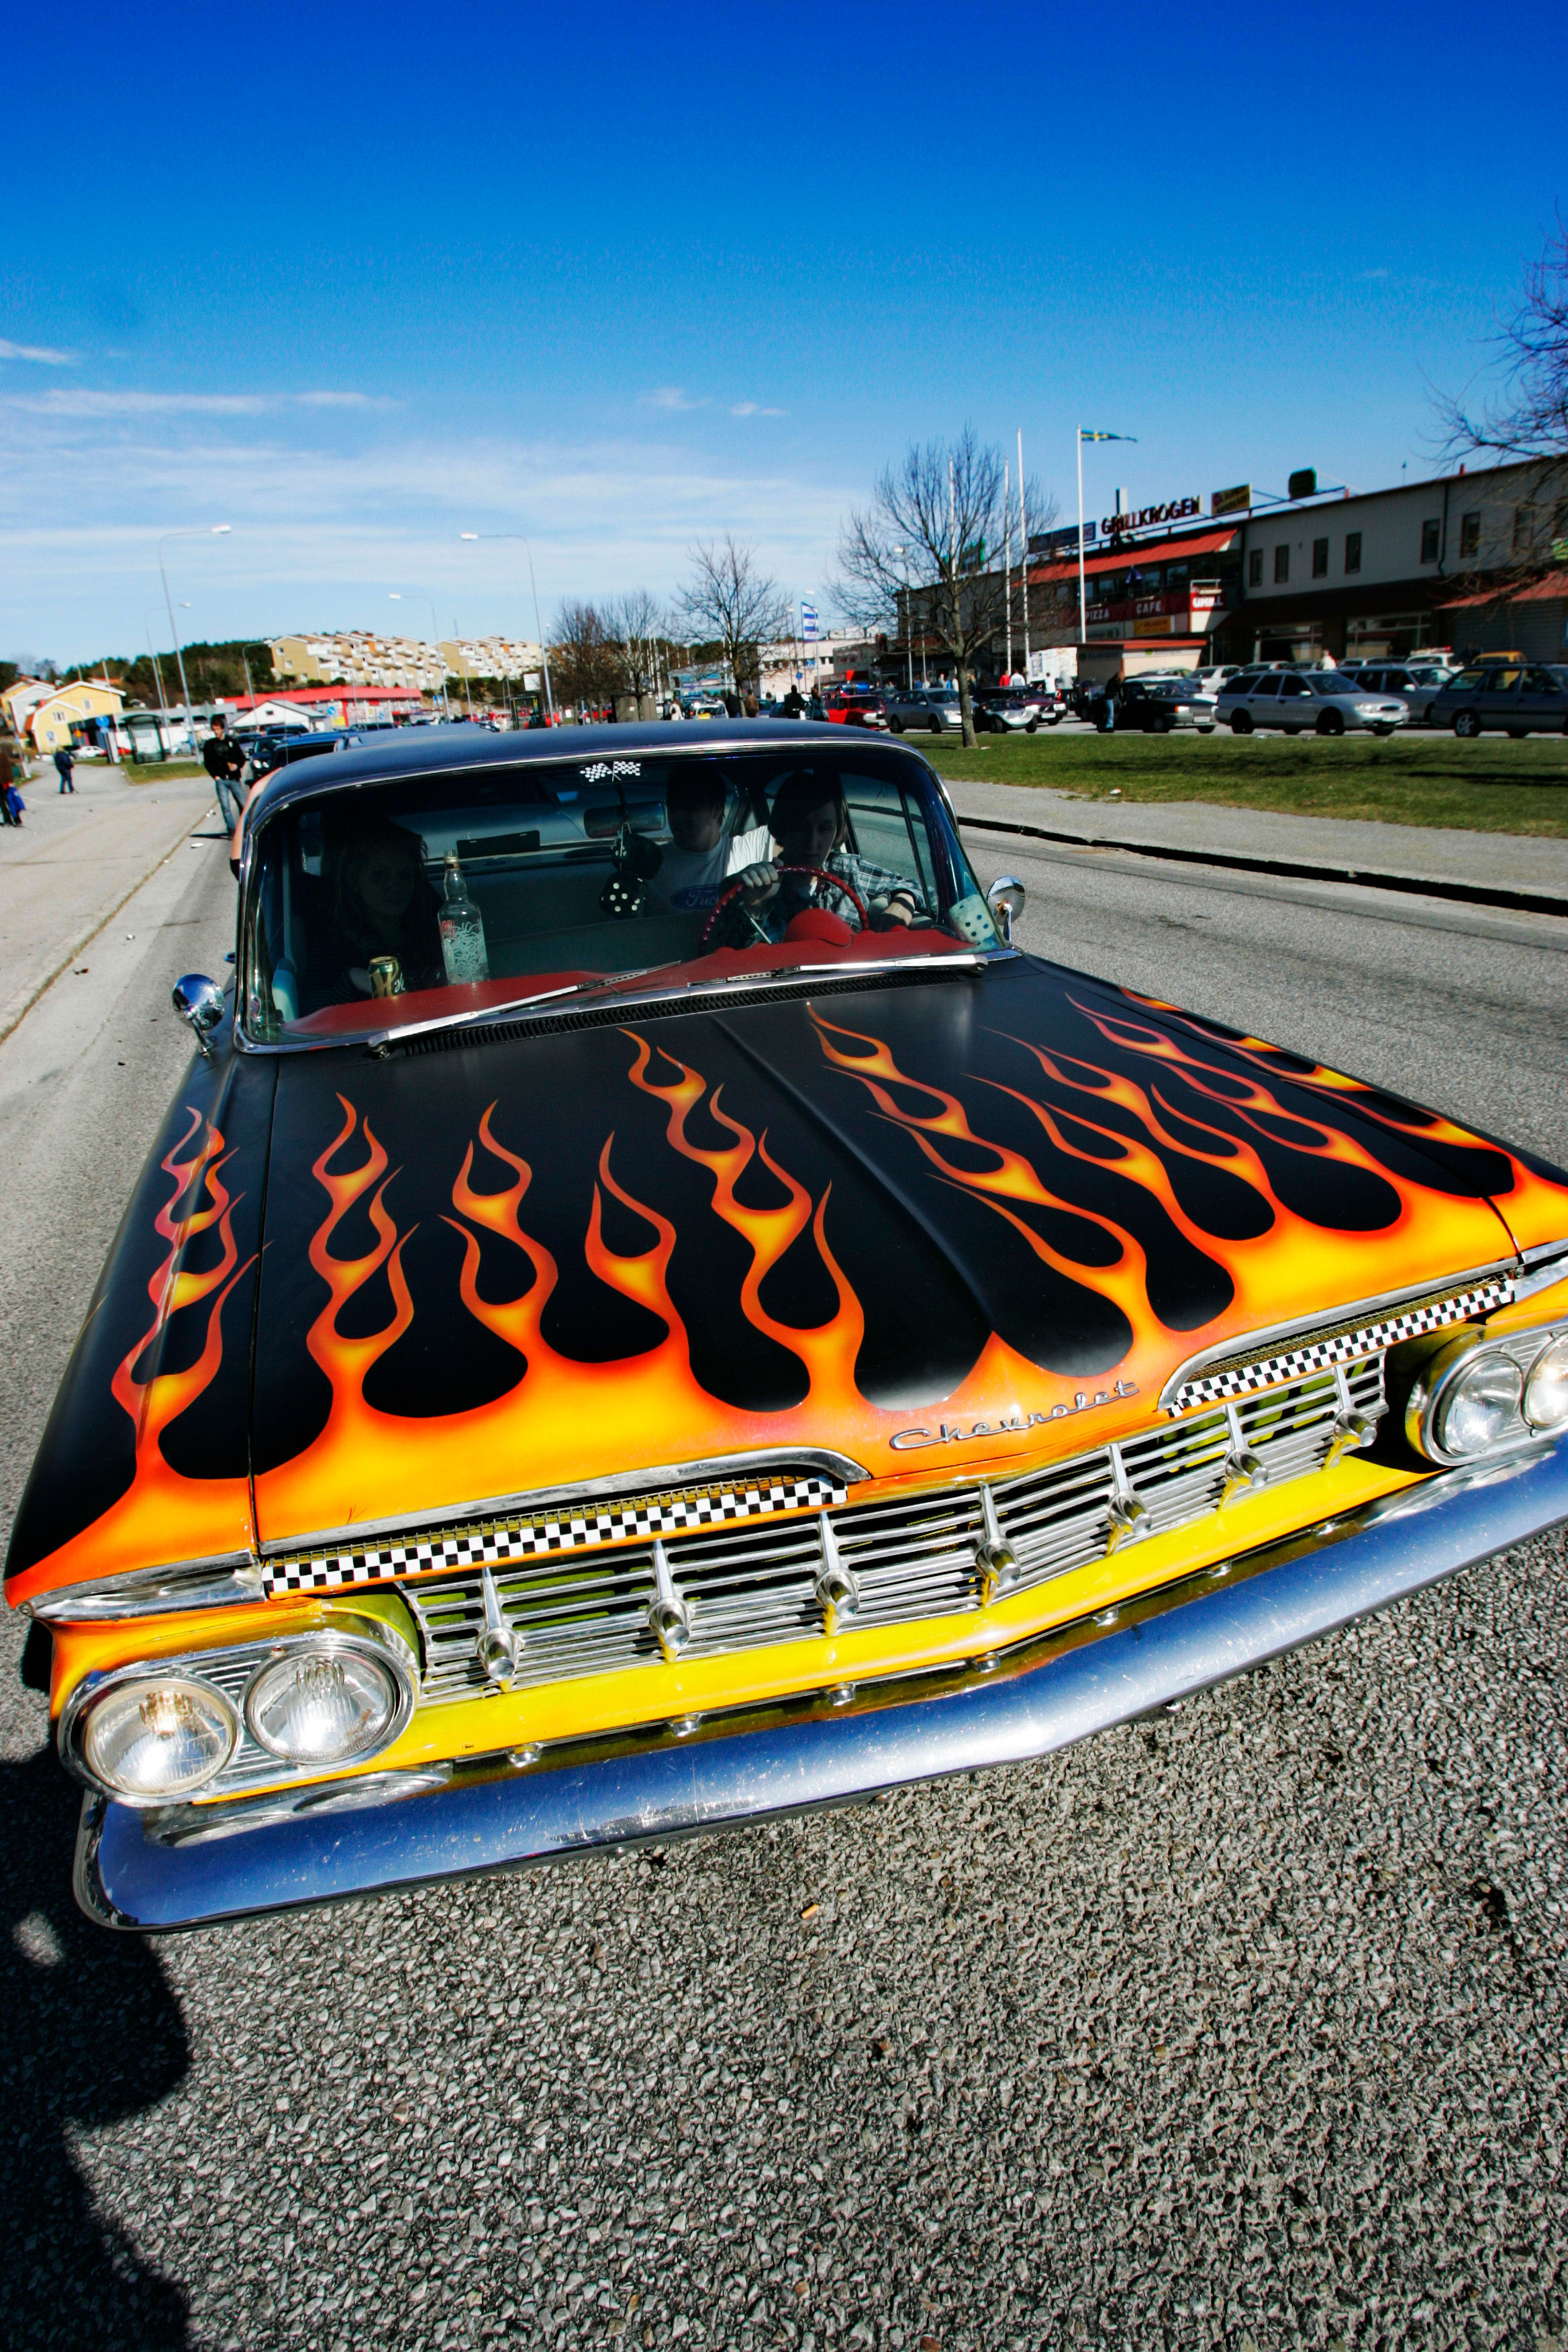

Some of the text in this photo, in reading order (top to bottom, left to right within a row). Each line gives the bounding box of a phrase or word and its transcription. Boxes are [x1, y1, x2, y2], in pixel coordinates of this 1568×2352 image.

[1085, 609, 1110, 620] PIZZA
[685, 889, 719, 907] Fuc
[889, 1380, 1140, 1449] Chevrolet
